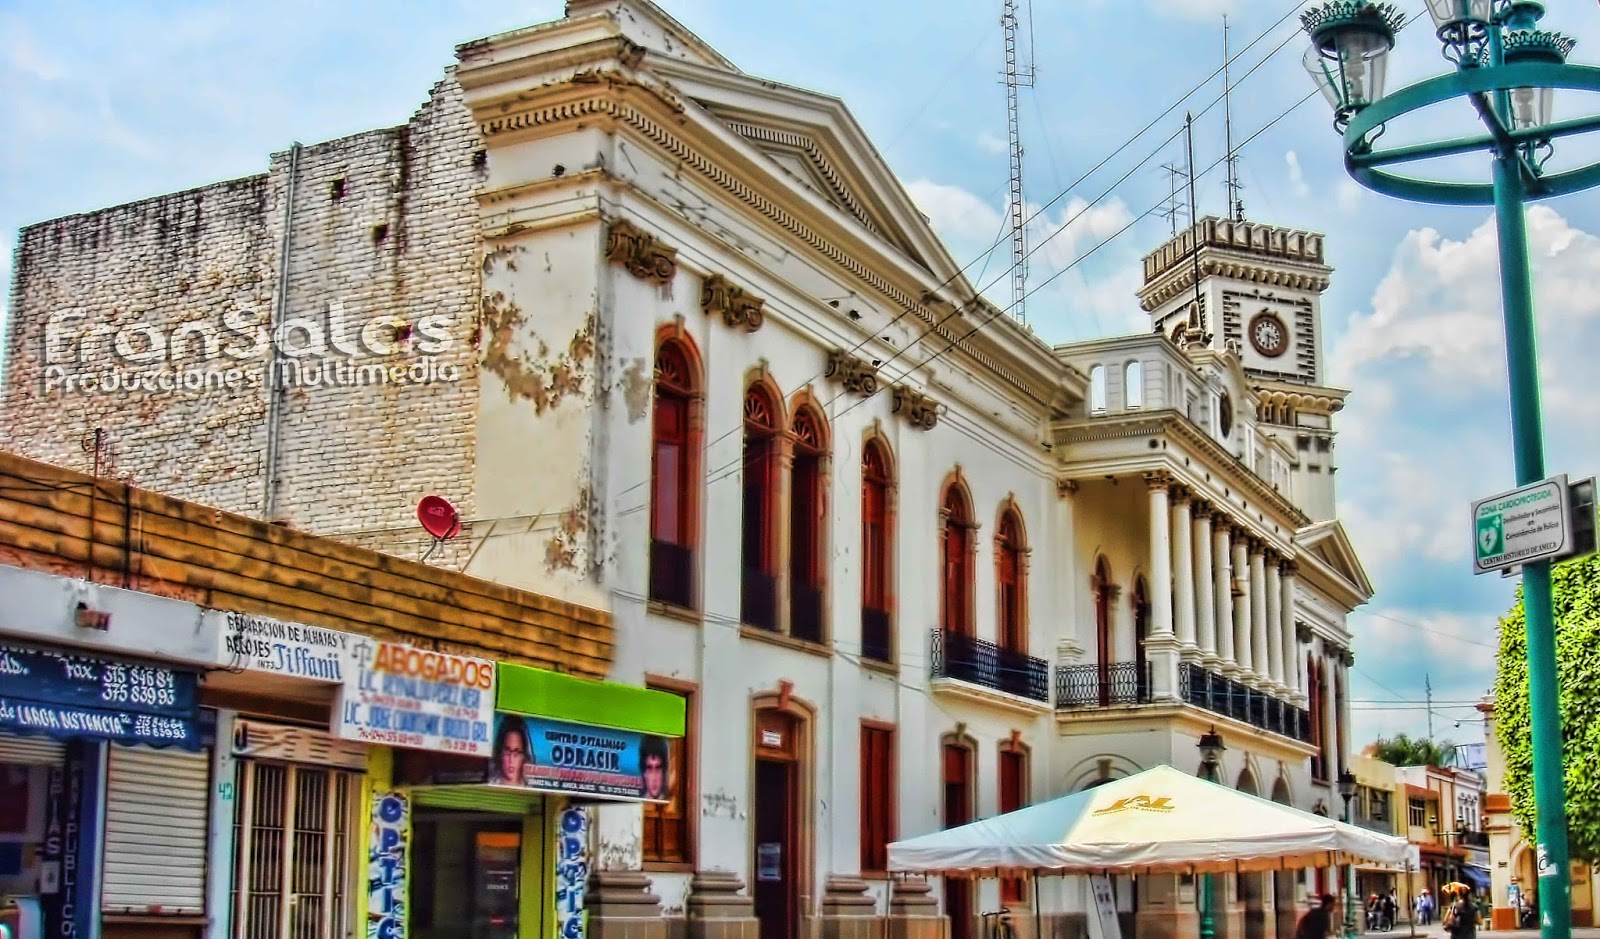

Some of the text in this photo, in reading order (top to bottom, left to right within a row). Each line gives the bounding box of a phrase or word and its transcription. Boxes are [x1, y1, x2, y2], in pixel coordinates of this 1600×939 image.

[1481, 505, 1497, 516] ZONA
[1483, 556, 1503, 566] CENTRO
[1530, 547, 1537, 555] DE
[1537, 541, 1557, 552] AMECA
[227, 615, 285, 640] REPARACION
[287, 625, 300, 643] DE
[339, 634, 348, 650] Y
[226, 635, 270, 658] RELOJES
[59, 657, 98, 681] Fax.
[130, 668, 154, 687] 846
[156, 670, 175, 689] 84
[371, 642, 494, 690] ABOGADOS
[102, 683, 175, 705] 375 839 93
[17, 705, 60, 728] LARGA
[59, 711, 125, 735] DISTANCIA
[545, 731, 579, 746] CENTRO
[551, 743, 621, 772] ODRACIR
[218, 782, 233, 800] 42
[61, 822, 78, 936] PUBLICO
